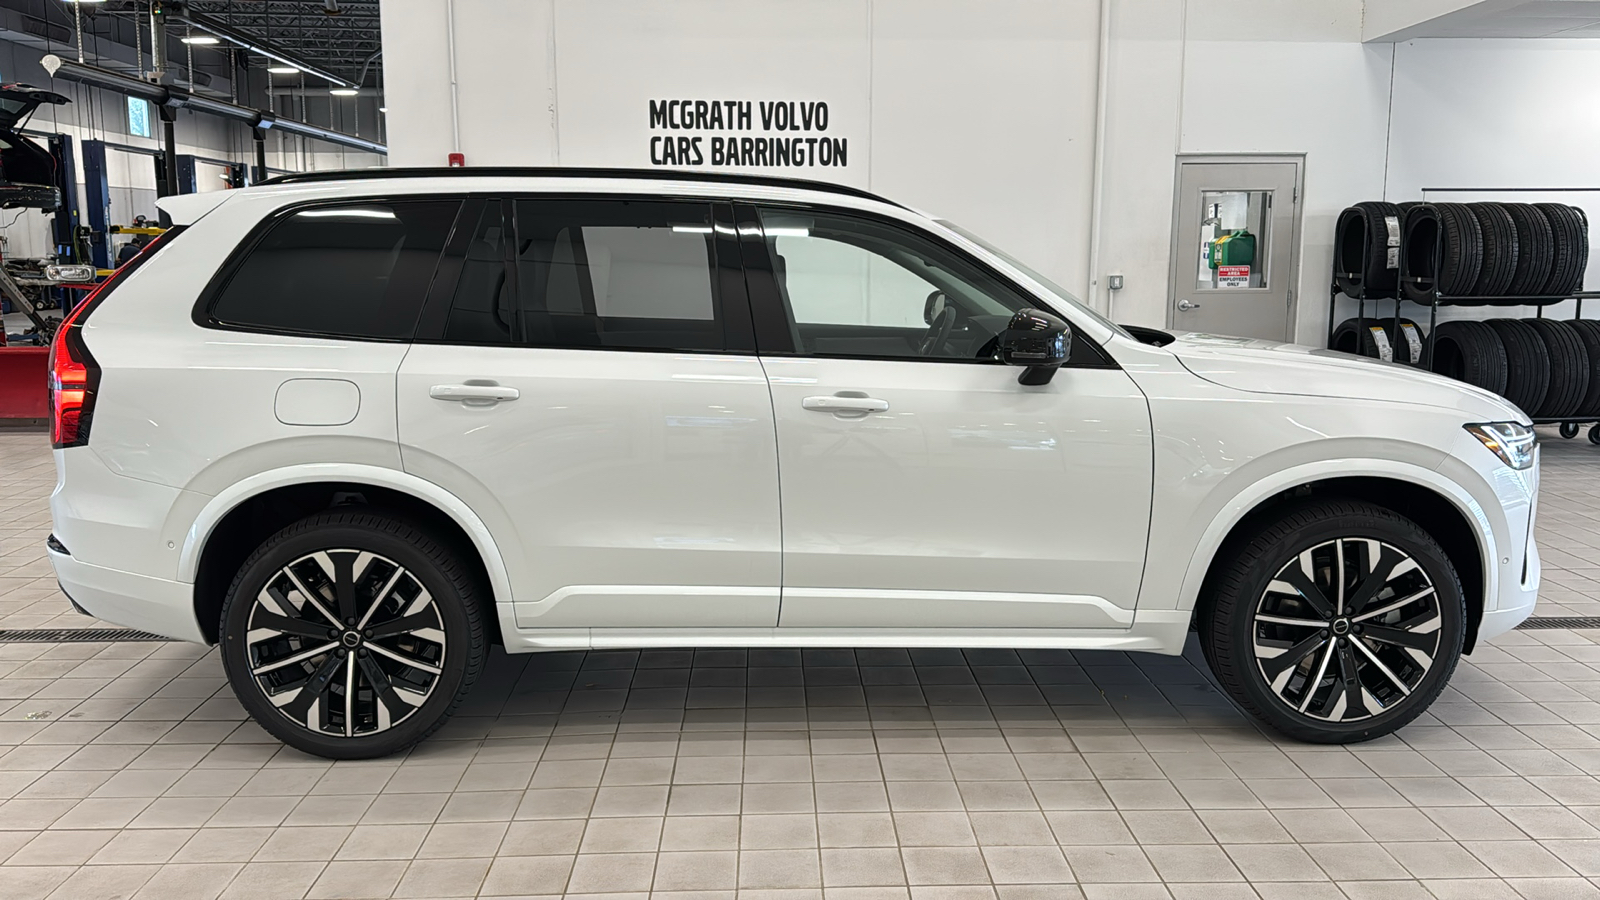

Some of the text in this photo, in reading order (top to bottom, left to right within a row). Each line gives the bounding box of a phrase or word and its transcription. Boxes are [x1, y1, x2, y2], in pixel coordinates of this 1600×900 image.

[649, 99, 829, 131] MCGRATH VOLVO
[650, 136, 847, 167] CARS BARRINGTON
